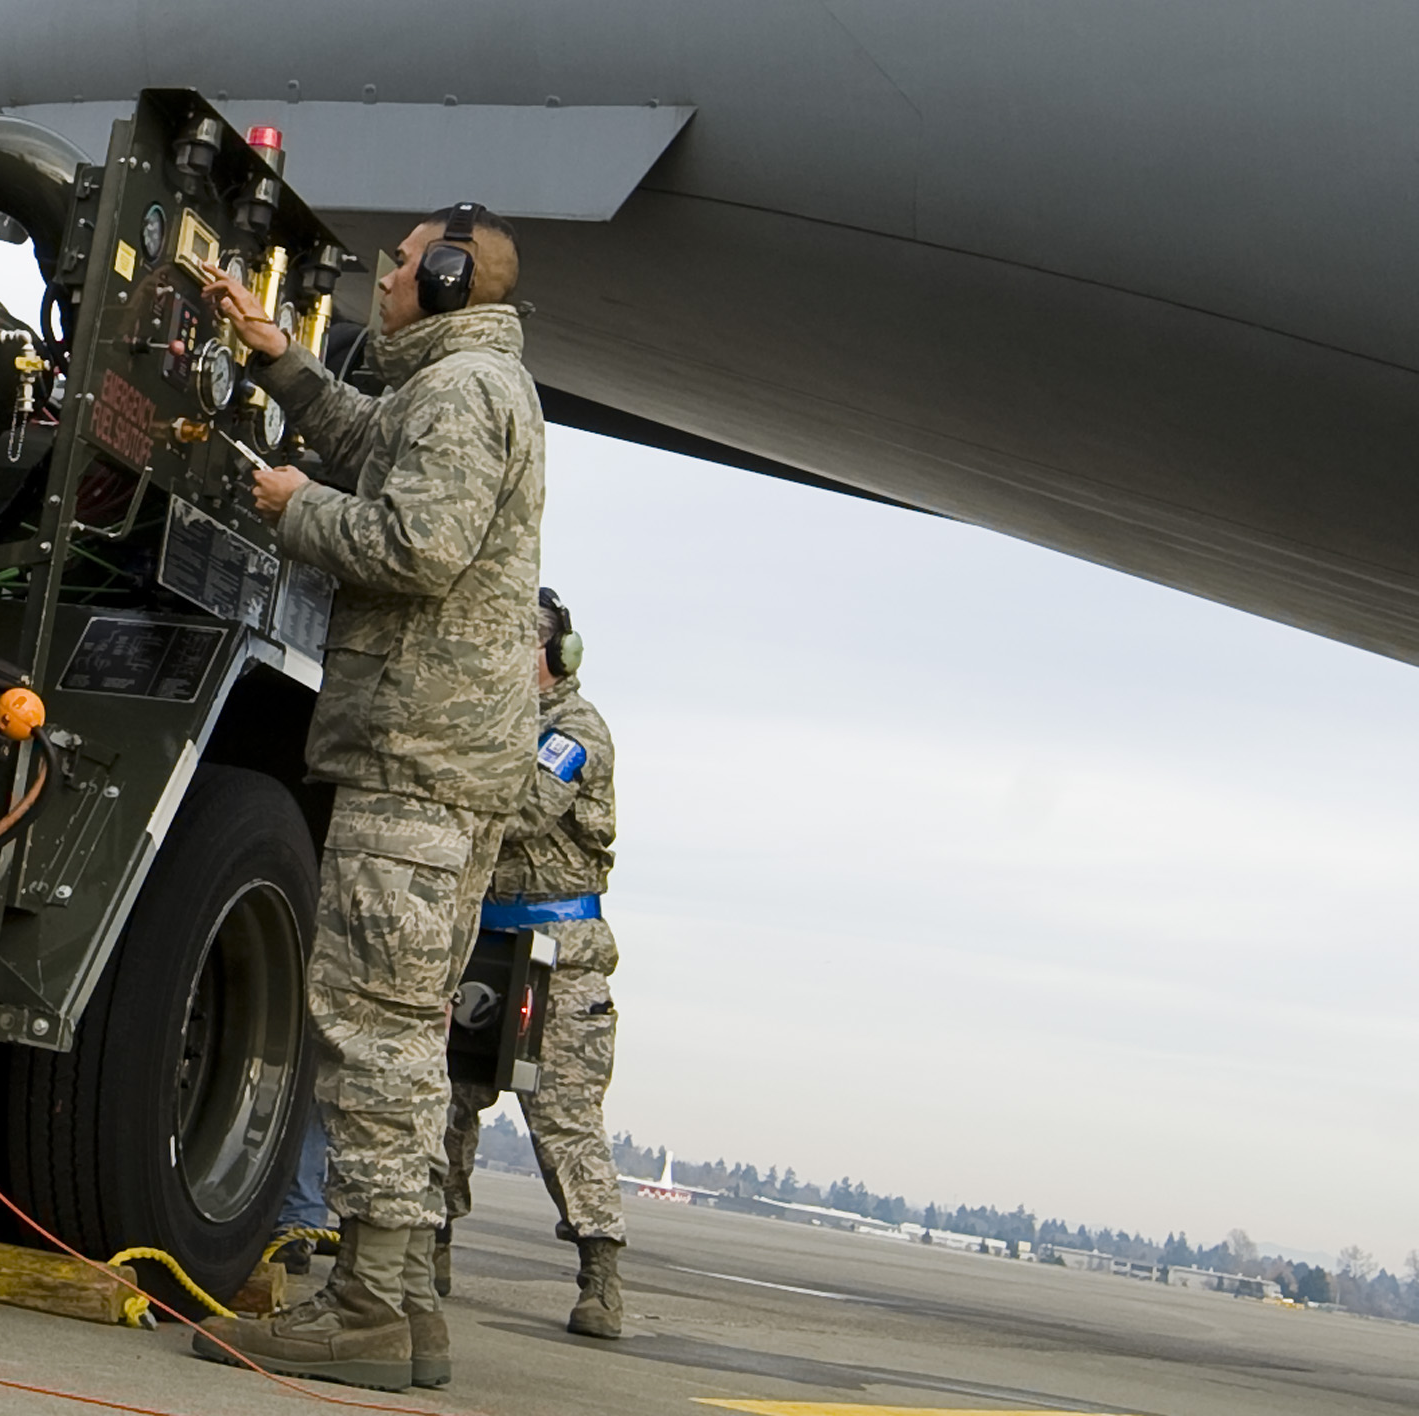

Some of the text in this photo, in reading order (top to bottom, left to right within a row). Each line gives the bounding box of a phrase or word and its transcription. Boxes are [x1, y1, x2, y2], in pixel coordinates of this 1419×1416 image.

[89, 400, 154, 466] FUEL SHUTOFF
[101, 368, 156, 433] EMERGENCY
